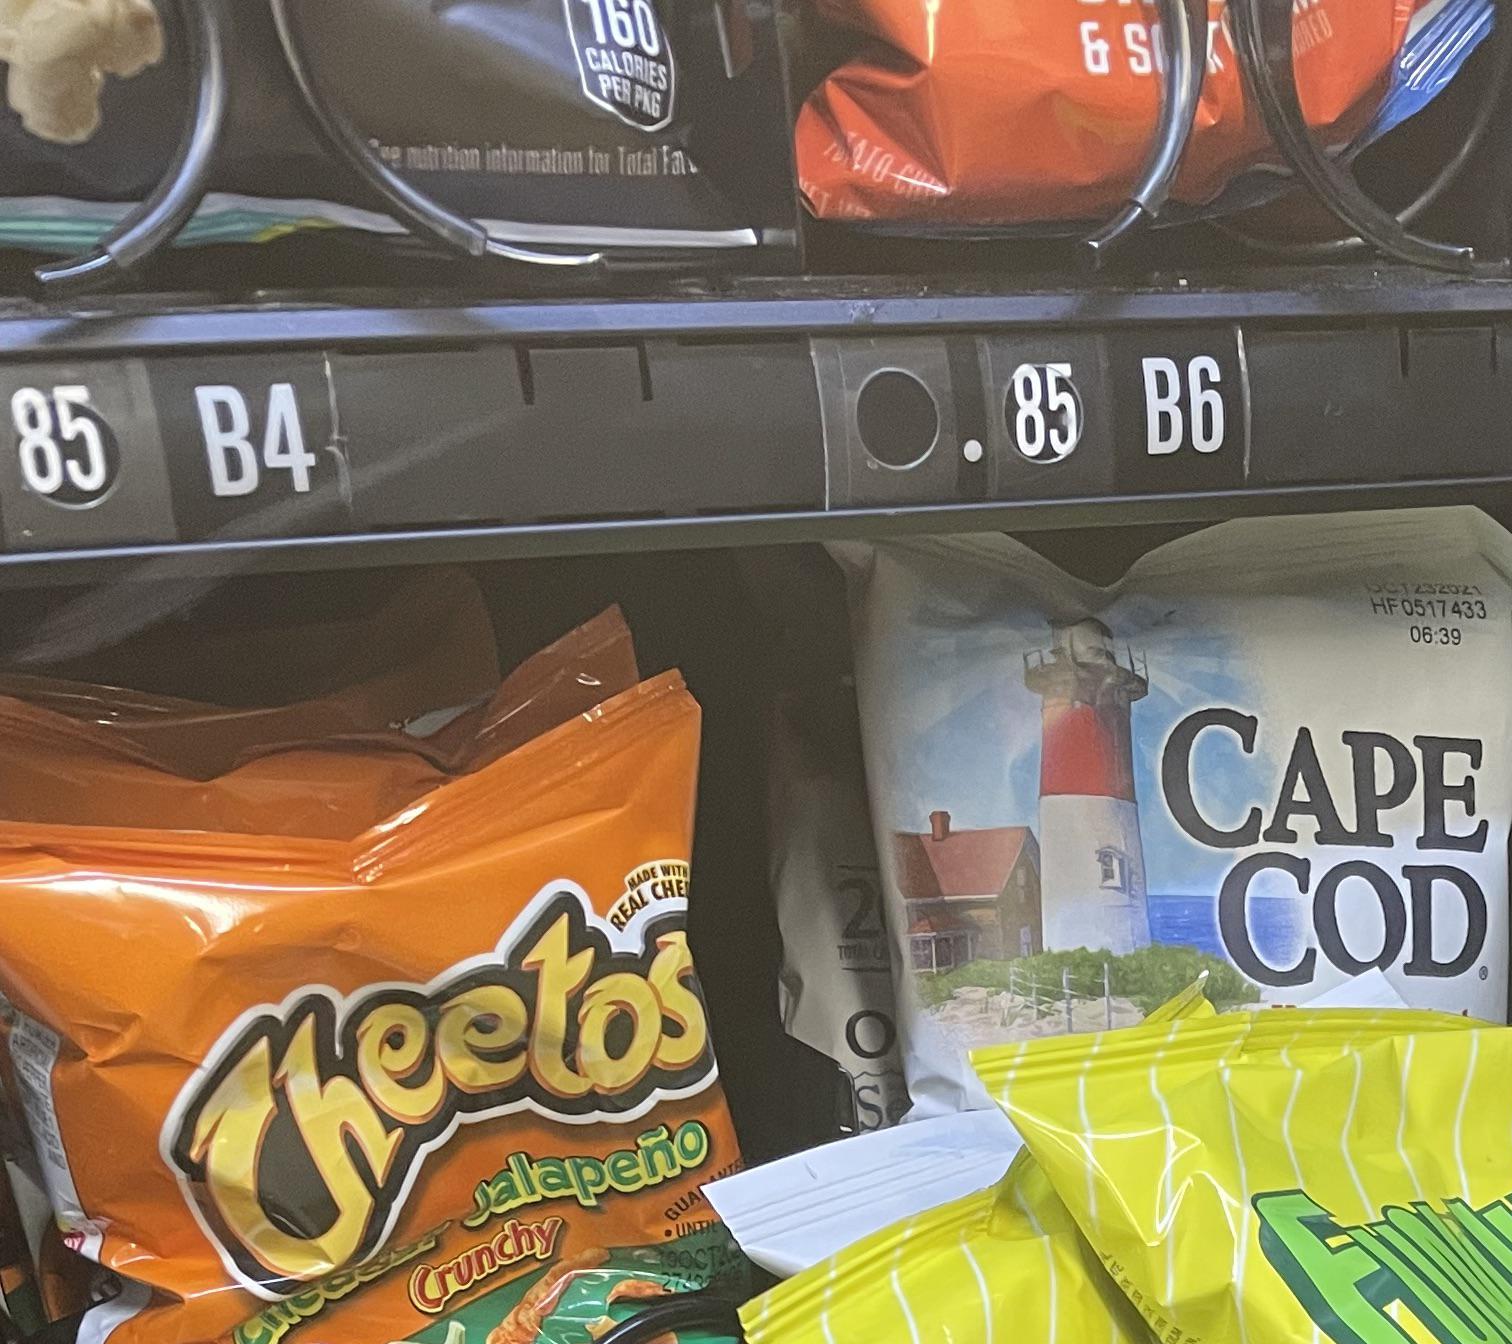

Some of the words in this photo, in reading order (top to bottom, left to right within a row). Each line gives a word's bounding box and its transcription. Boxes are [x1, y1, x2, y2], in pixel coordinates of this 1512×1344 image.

[588, 0, 661, 57] 160
[1080, 21, 1110, 75] &
[585, 47, 668, 92] CALORIES
[599, 73, 632, 105] PER
[633, 84, 661, 118] PKG
[486, 142, 583, 174] information
[588, 145, 610, 174] for
[618, 146, 657, 175] Total
[1142, 356, 1225, 456] B6
[12, 386, 108, 497] 85
[195, 383, 315, 497] B4
[1410, 626, 1462, 645] 06:39
[1160, 707, 1491, 854] CAPE
[627, 866, 659, 892] MADE
[660, 863, 688, 878] WITH
[610, 889, 650, 932] REAL
[1217, 851, 1489, 989] COD
[189, 912, 708, 1276] Cheetos
[407, 1216, 566, 1315] Crunchy
